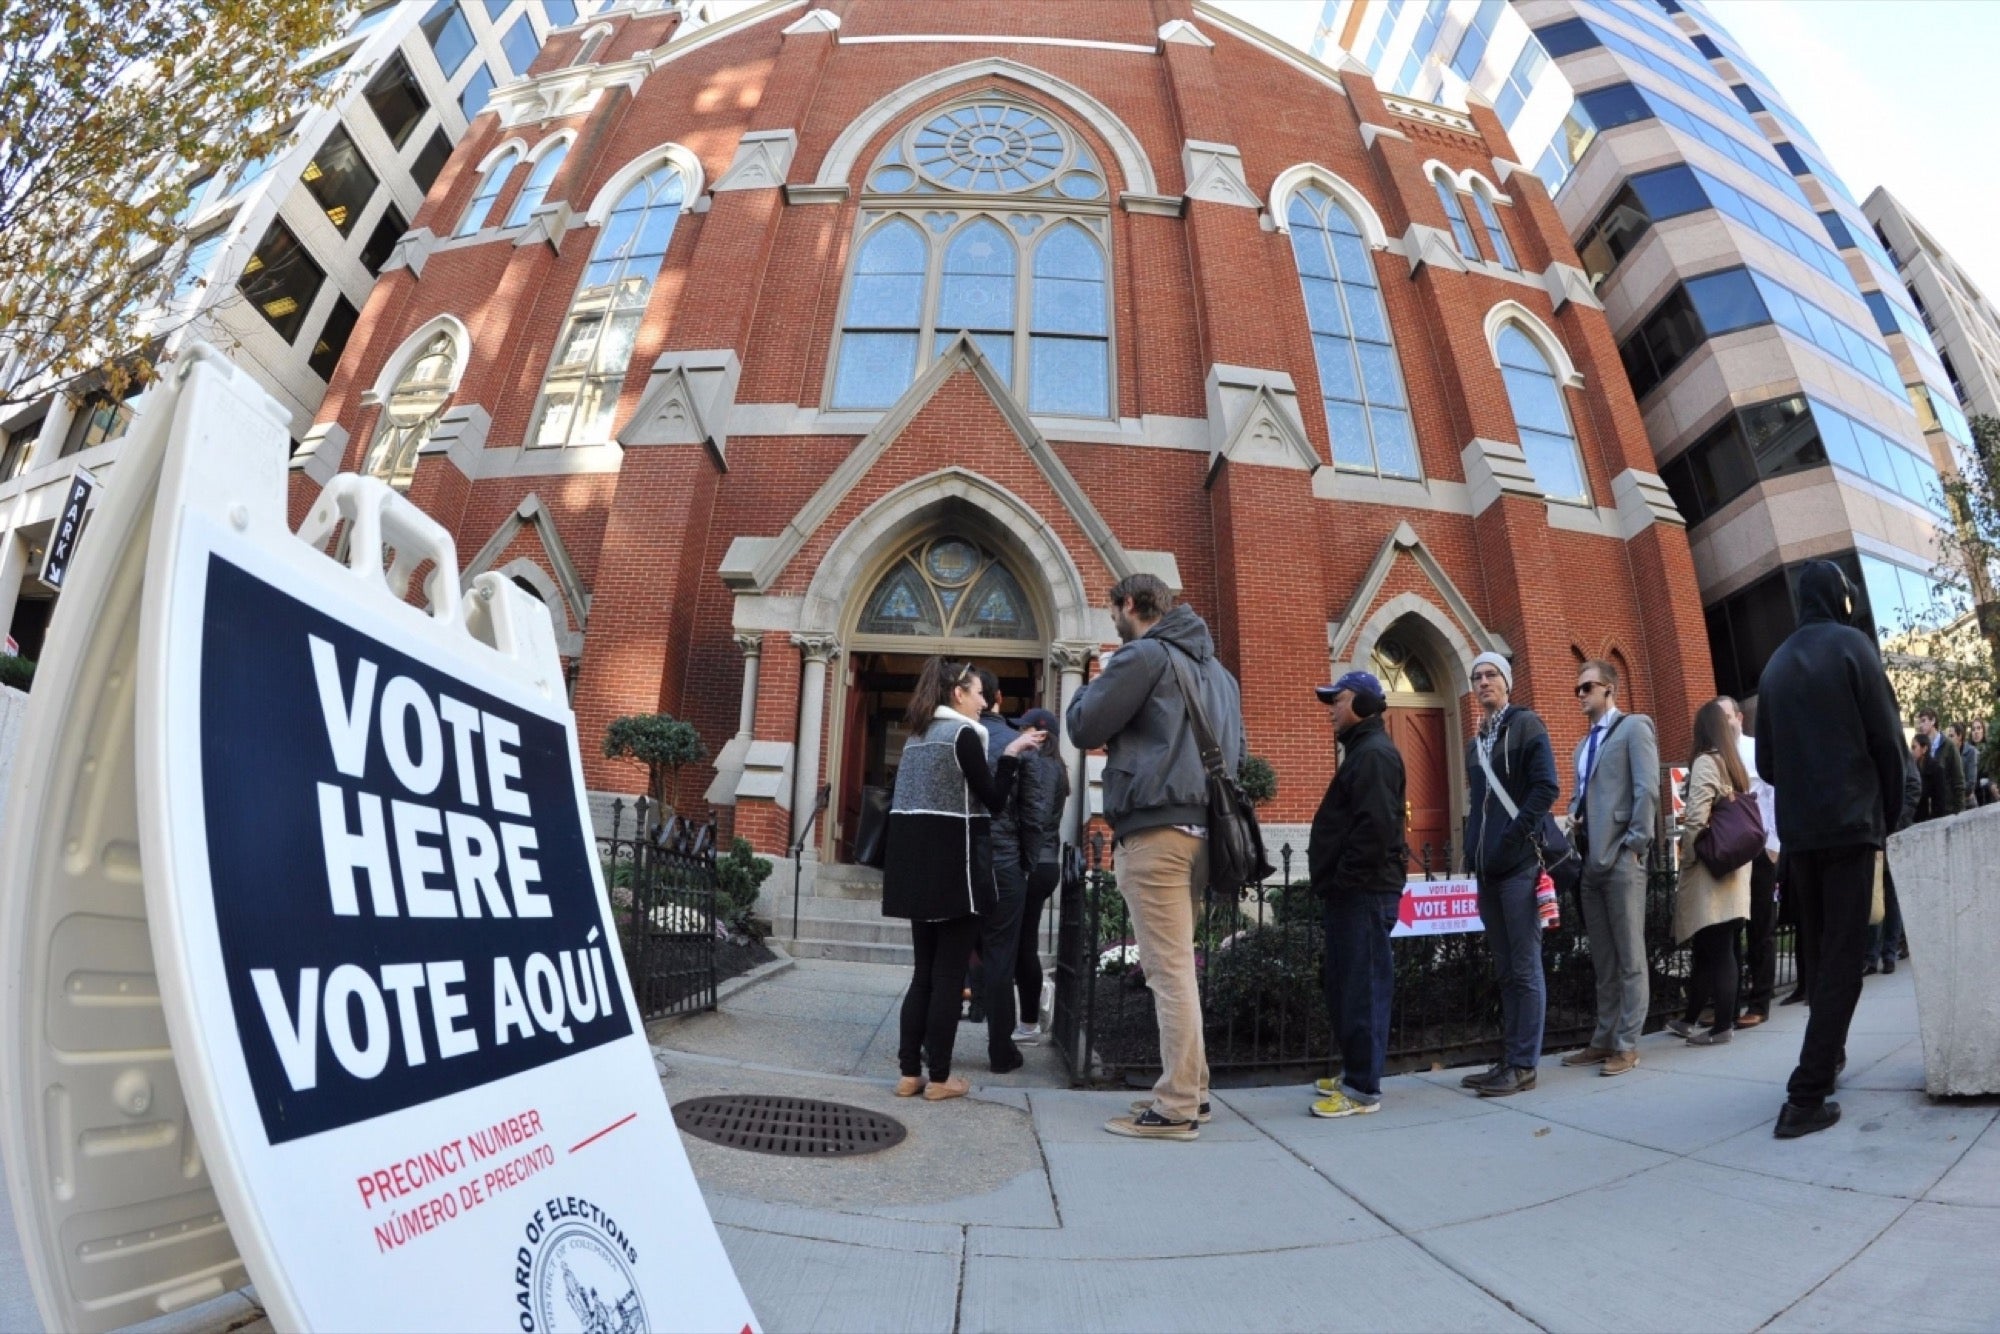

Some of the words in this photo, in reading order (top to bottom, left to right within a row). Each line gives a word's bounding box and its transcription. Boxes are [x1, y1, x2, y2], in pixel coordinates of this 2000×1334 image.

[57, 485, 86, 559] PARK
[308, 633, 531, 817] VOTE
[317, 781, 553, 918] HERE
[1413, 901, 1447, 917] VOTE
[1451, 899, 1479, 915] HER
[250, 960, 479, 1091] VOTE
[494, 926, 613, 1045] AQUÍ
[357, 1140, 466, 1209] PRECINCT
[467, 1109, 544, 1162] NUMBER
[374, 1193, 458, 1254] NÚMERO
[459, 1179, 485, 1210] DE
[484, 1144, 555, 1197] PRECINTO
[515, 1247, 535, 1333] OARD
[526, 1209, 545, 1244] OF
[546, 1196, 638, 1264] ELECTIONS
